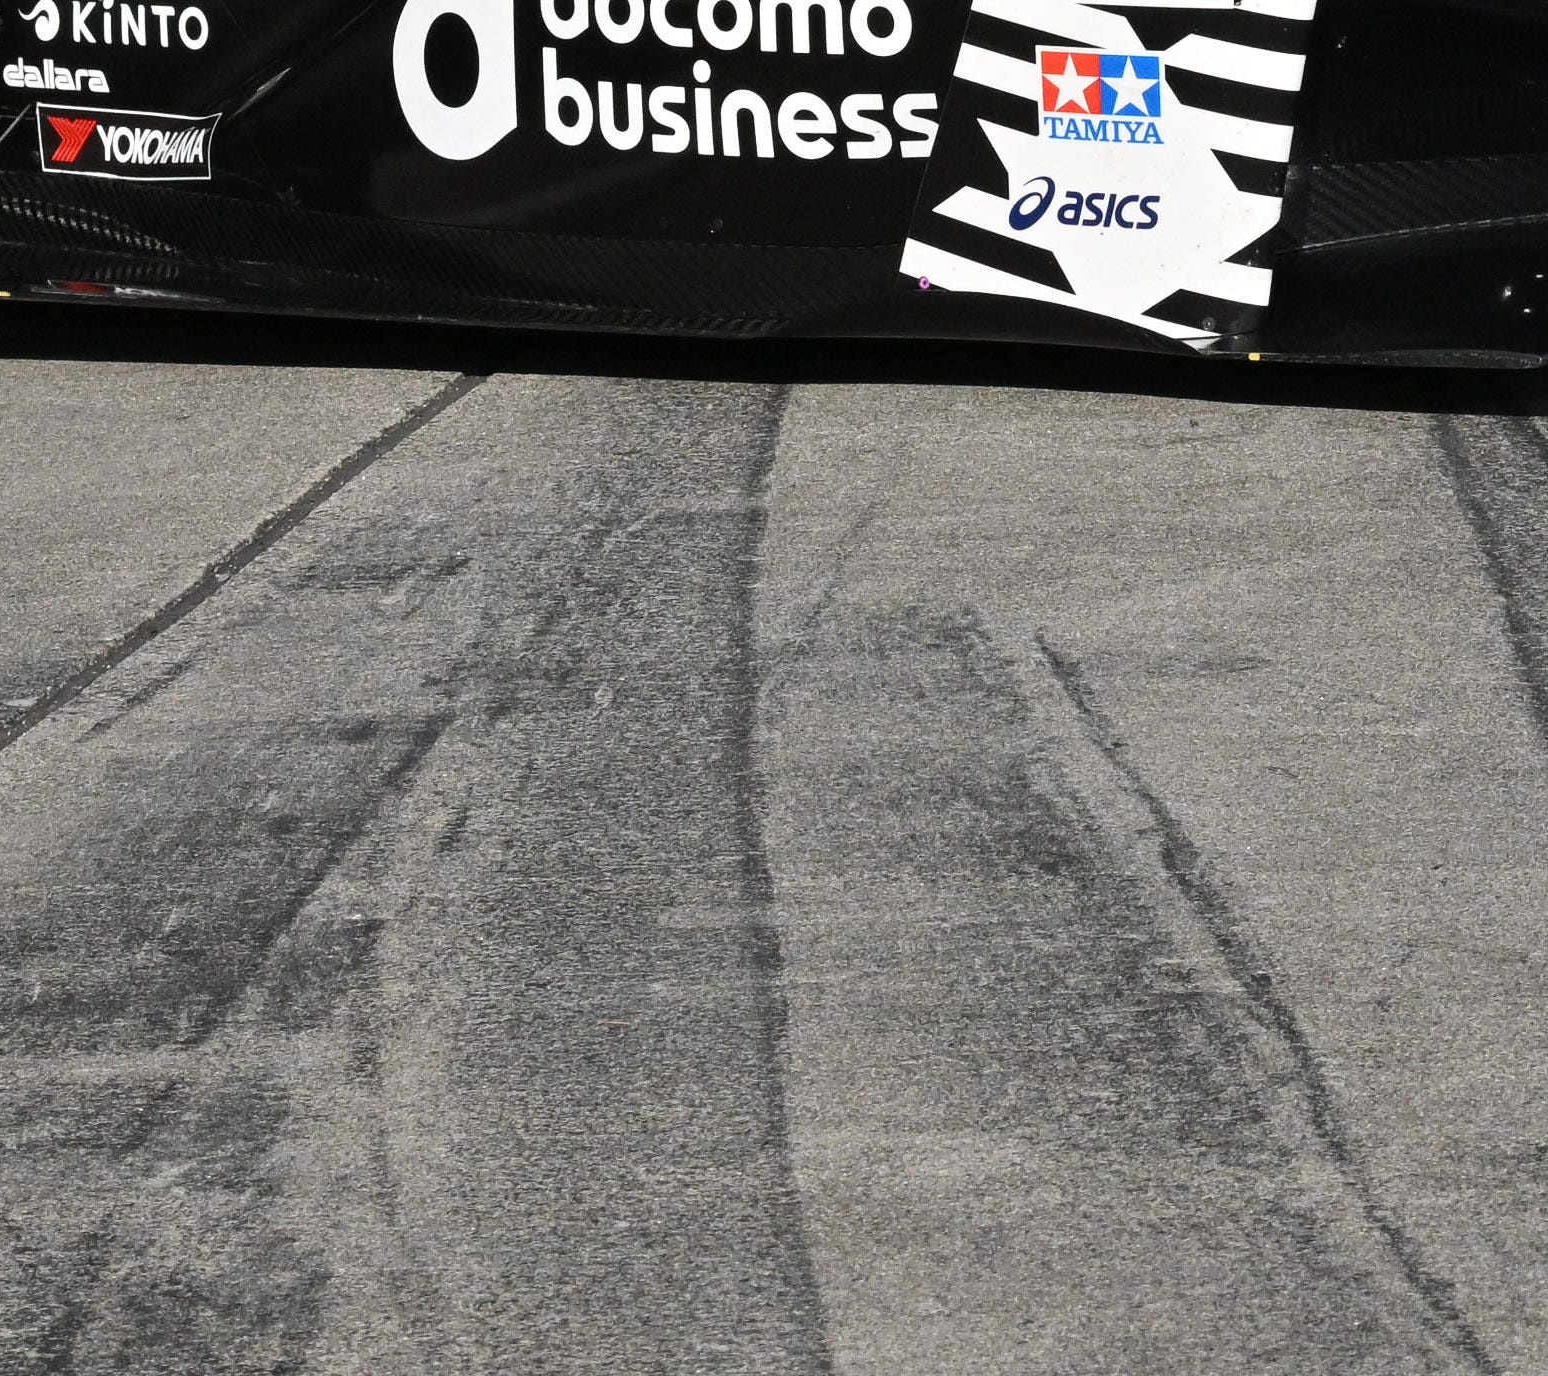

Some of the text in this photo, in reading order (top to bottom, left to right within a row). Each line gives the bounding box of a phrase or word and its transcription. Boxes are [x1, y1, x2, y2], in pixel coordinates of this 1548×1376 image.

[2, 57, 111, 93] dallara
[543, 47, 940, 159] business
[95, 120, 205, 167] YOKOHAMA
[1043, 116, 1164, 146] TAMIYA
[1056, 186, 1161, 231] asics
